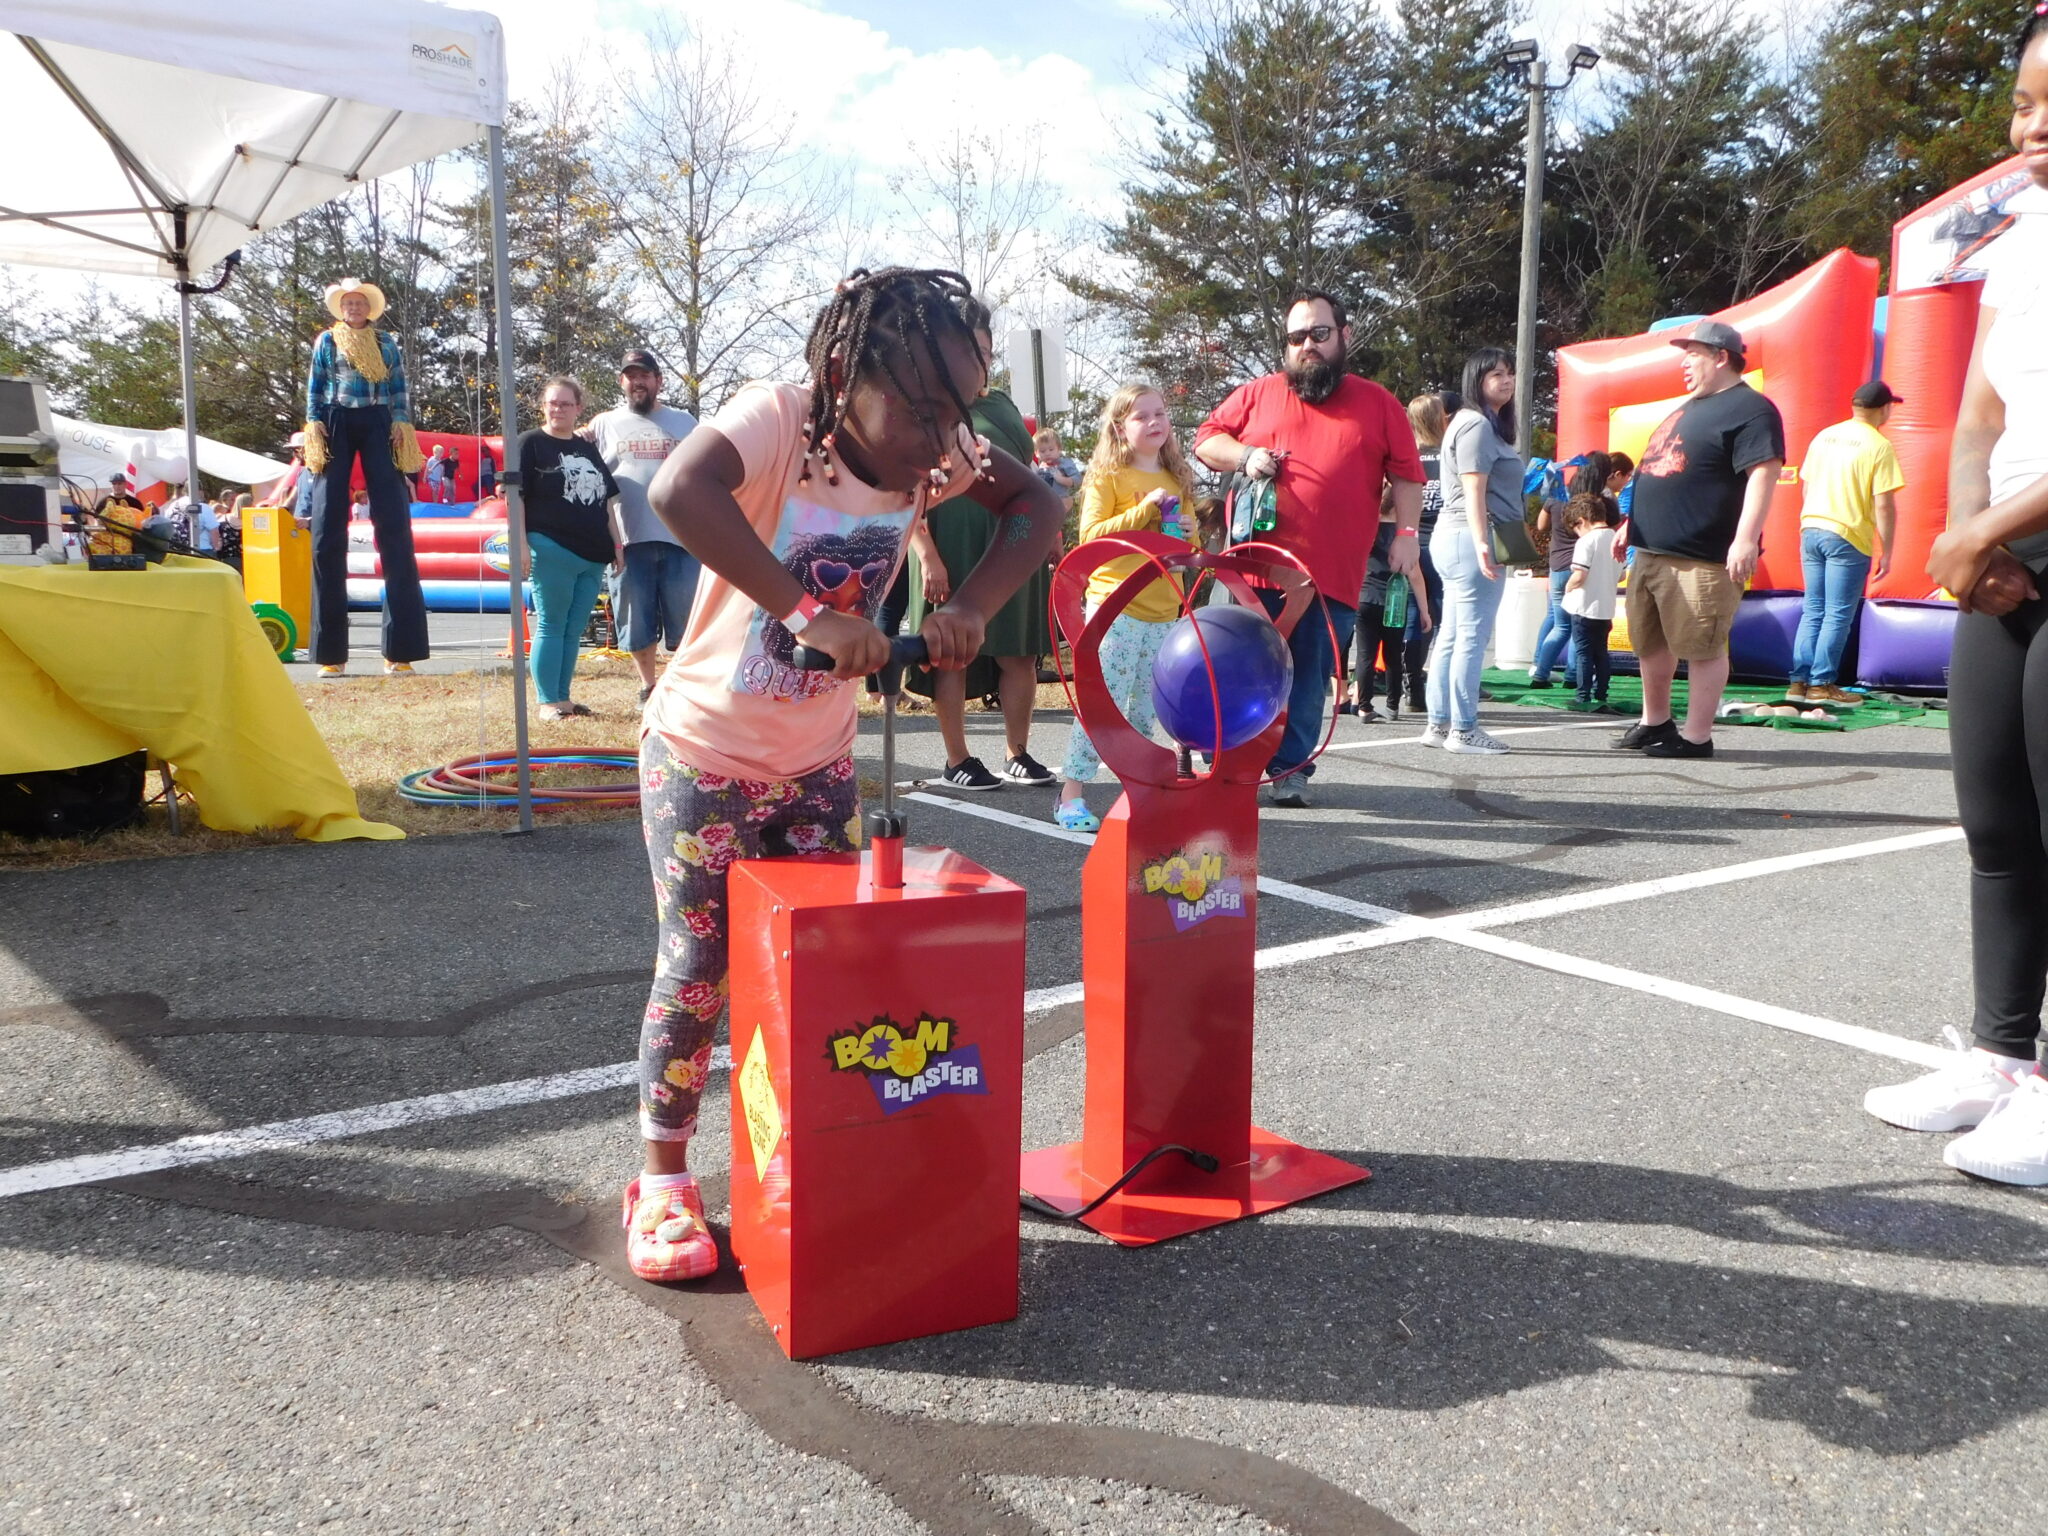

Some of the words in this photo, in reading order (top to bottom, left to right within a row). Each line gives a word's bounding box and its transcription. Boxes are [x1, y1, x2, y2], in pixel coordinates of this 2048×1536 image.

[411, 43, 473, 70] PROSHADE
[1144, 855, 1222, 901] BOOM
[1177, 888, 1241, 921] BLASTER
[833, 1020, 949, 1077] BOOM
[884, 1061, 978, 1102] BLASTER
